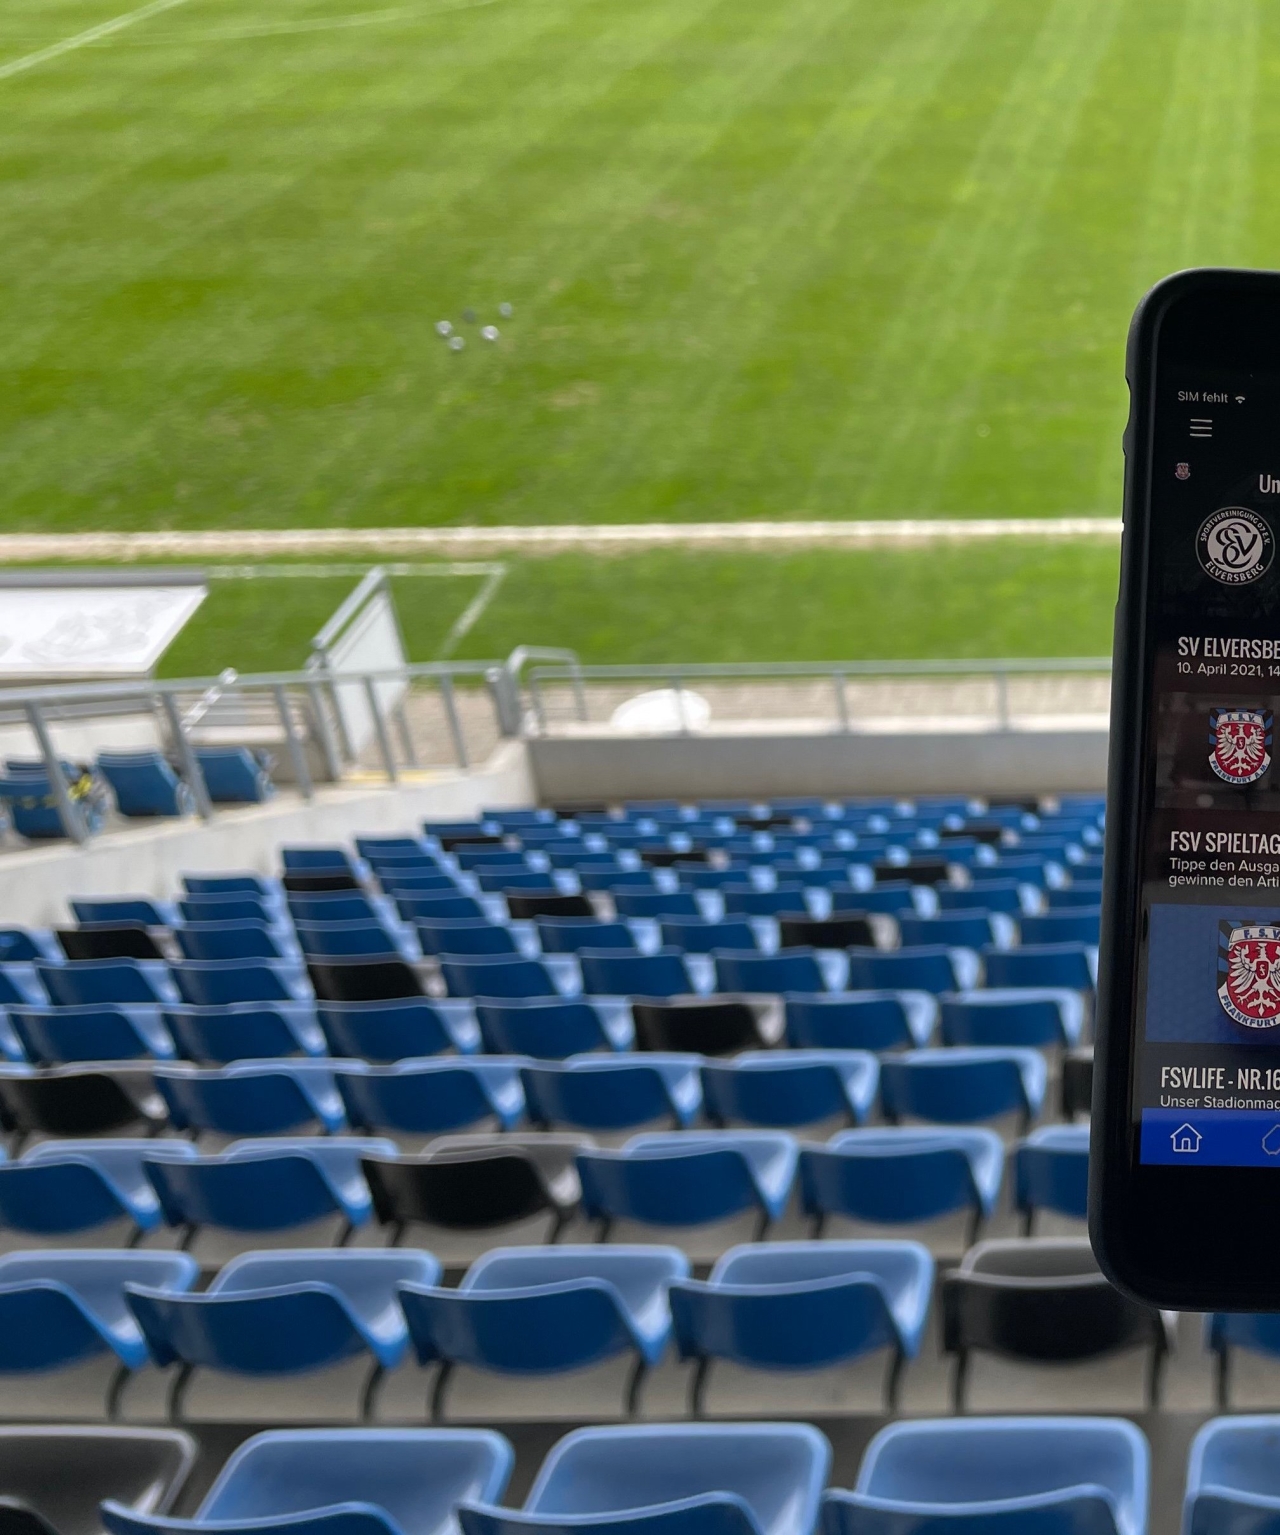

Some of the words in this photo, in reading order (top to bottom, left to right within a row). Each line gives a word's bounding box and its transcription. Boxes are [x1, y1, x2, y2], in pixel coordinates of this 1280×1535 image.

[1177, 390, 1199, 401] SIM
[1202, 392, 1229, 403] fehlt
[1200, 510, 1258, 542] SPORTVEREINIGUNG
[1205, 560, 1264, 582] ELVERSBERG
[1177, 636, 1200, 656] SV
[1177, 662, 1193, 674] 10.
[1197, 663, 1227, 676] April
[1230, 664, 1265, 678] 2021,
[1170, 830, 1201, 852] FSV
[1169, 857, 1206, 873] Tippe
[1210, 859, 1235, 872] den
[1168, 875, 1224, 888] gewinne
[1228, 875, 1253, 887] den
[1222, 995, 1277, 1027] FRANKFURT
[1161, 1066, 1226, 1090] FSVLIFE
[1160, 1095, 1200, 1108] Unser
